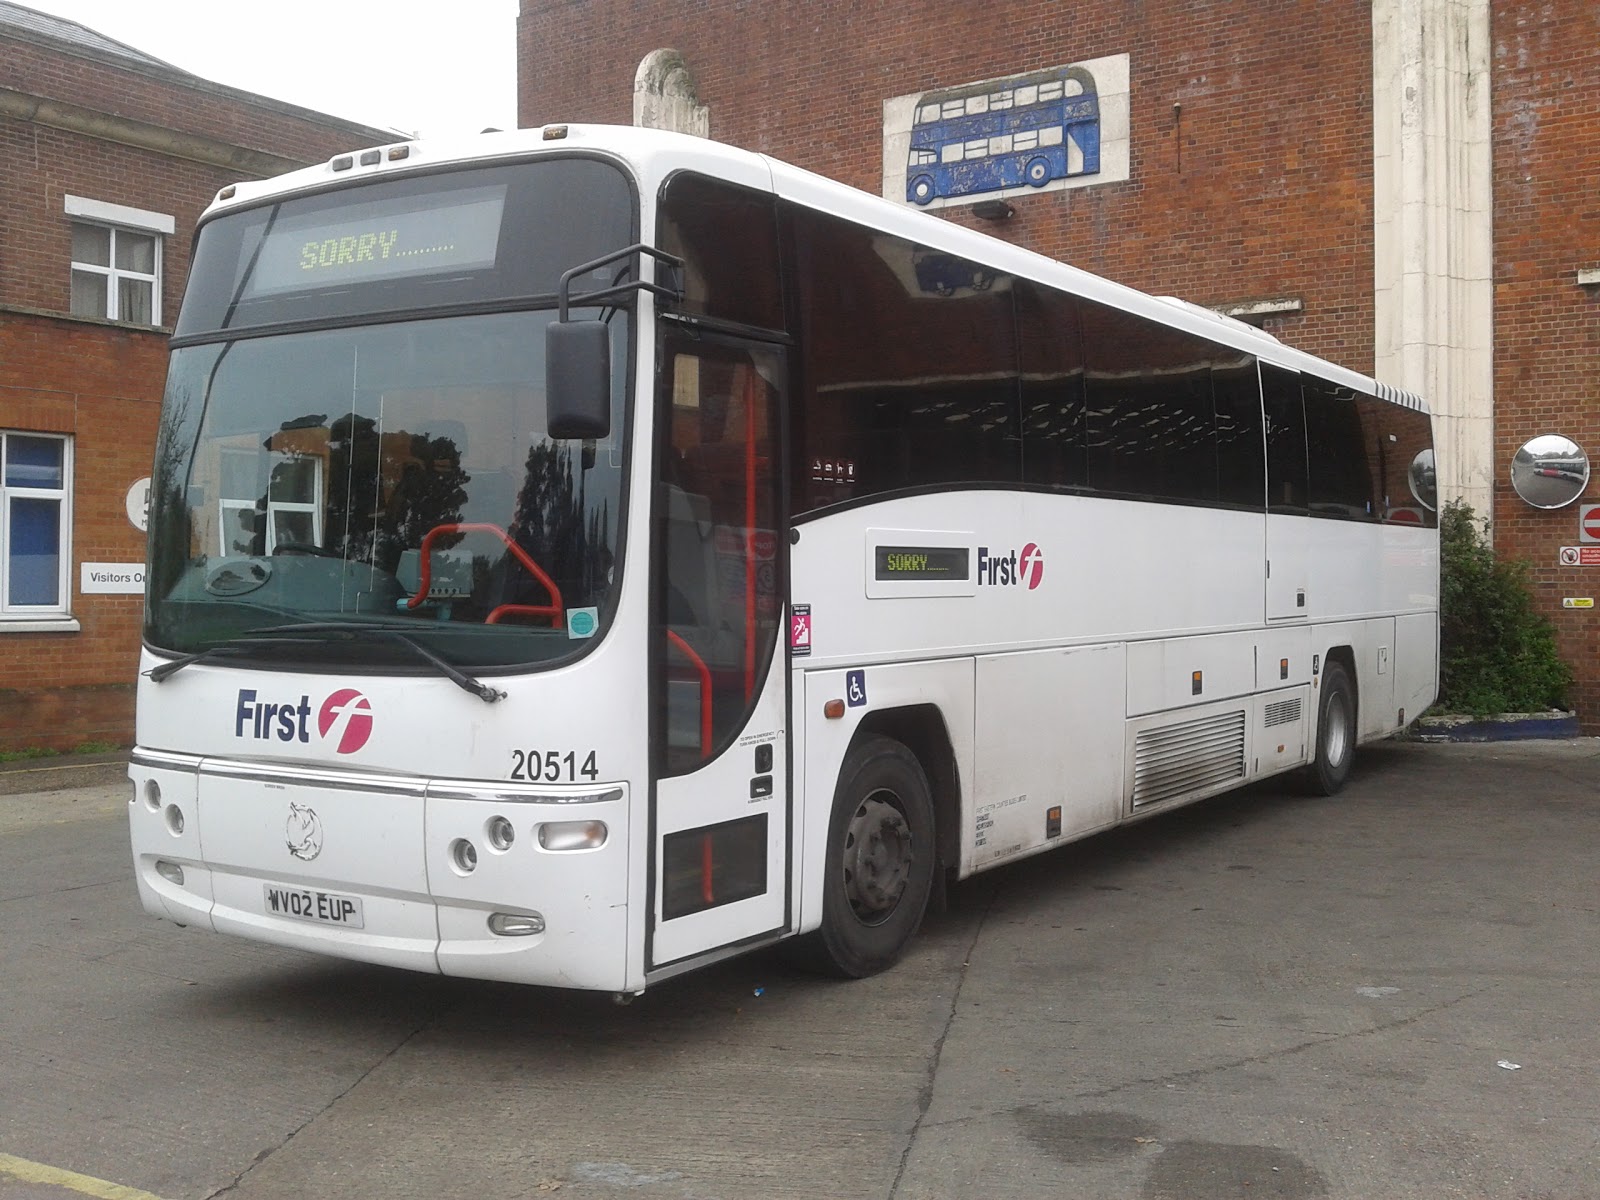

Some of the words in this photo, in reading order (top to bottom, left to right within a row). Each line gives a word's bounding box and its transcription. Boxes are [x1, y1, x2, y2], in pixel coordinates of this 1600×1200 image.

[90, 572, 131, 583] Visitors
[976, 547, 1017, 586] First
[235, 688, 311, 743] First
[510, 749, 599, 782] 20514
[268, 889, 313, 918] WV02
[317, 896, 356, 922] EUP
